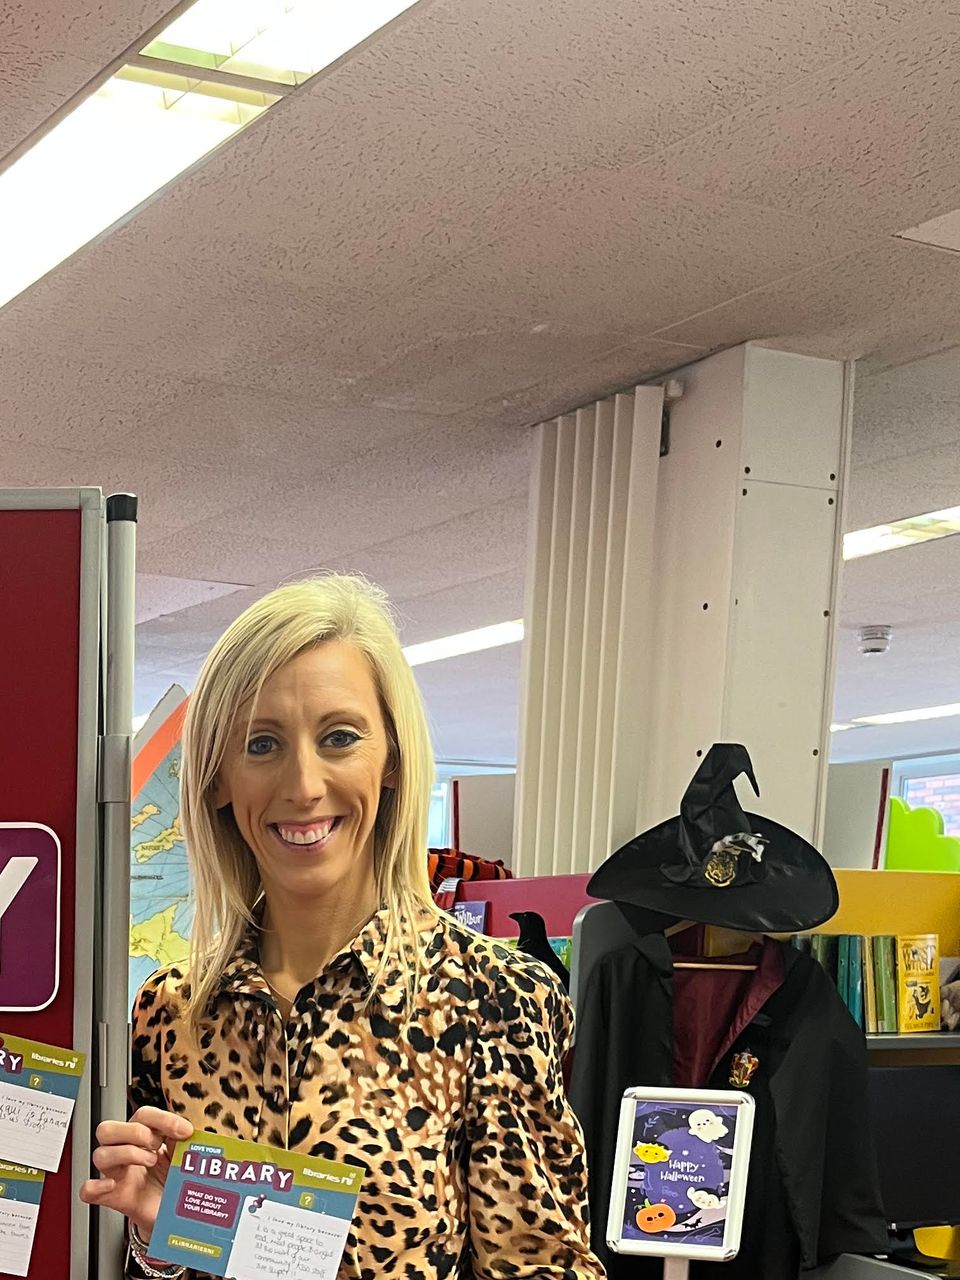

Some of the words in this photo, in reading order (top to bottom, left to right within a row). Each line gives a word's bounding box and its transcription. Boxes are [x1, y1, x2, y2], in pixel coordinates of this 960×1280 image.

[184, 1153, 292, 1188] LIBRARY
[668, 1160, 699, 1172] Happy
[660, 1171, 705, 1182] Halloween
[185, 1197, 201, 1206] LOVE
[201, 1201, 221, 1210] ABOUT
[187, 1189, 204, 1199] WHAT
[204, 1193, 213, 1201] DO
[214, 1195, 227, 1204] YOU
[184, 1204, 200, 1213] YOUR
[200, 1207, 228, 1219] LIBRARY?
